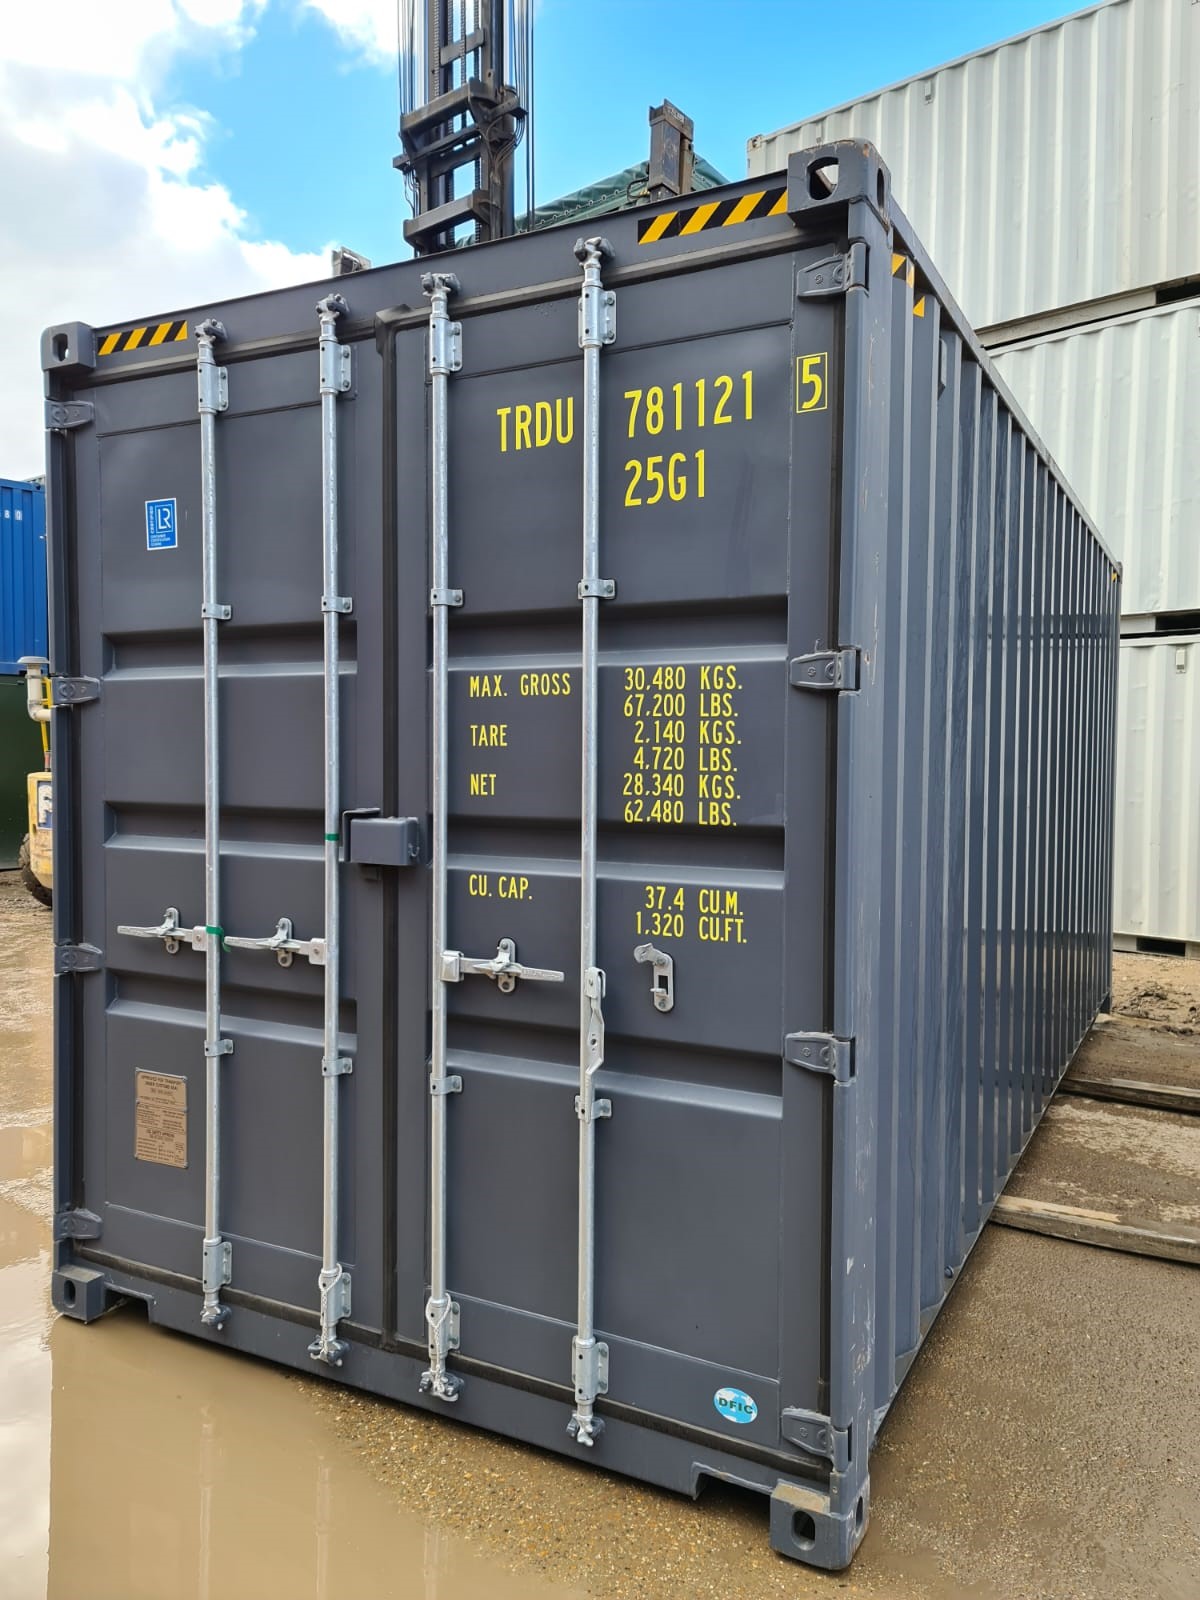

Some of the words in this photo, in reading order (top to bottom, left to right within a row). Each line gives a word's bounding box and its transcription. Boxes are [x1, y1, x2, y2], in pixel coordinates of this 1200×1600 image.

[496, 396, 574, 453] TRDU
[624, 370, 753, 439] 781121
[801, 356, 823, 410] 5
[624, 448, 706, 507] 25G1
[157, 507, 172, 530] LR
[469, 674, 508, 697] MAX.
[519, 672, 571, 696] GROSS
[624, 666, 686, 691] 30,480
[700, 665, 743, 690] KGS.
[623, 693, 686, 717] 67,200
[699, 692, 739, 718] LBS.
[470, 724, 508, 747] TARE
[634, 720, 685, 744] 2,140
[699, 719, 742, 745] KGS.
[633, 746, 685, 770] 4,720
[699, 747, 738, 772] LBS.
[470, 773, 497, 796] NET
[622, 773, 685, 797] 28,340
[699, 774, 741, 800] KGS.
[698, 801, 737, 827] LBS.
[468, 874, 492, 897] CU.
[498, 876, 533, 900] CAP.
[645, 885, 685, 911] 37.4
[698, 889, 744, 916] CU.M.
[635, 911, 685, 938] 1,320
[698, 916, 748, 944] CU.FT.
[718, 1397, 753, 1415] DFIC
